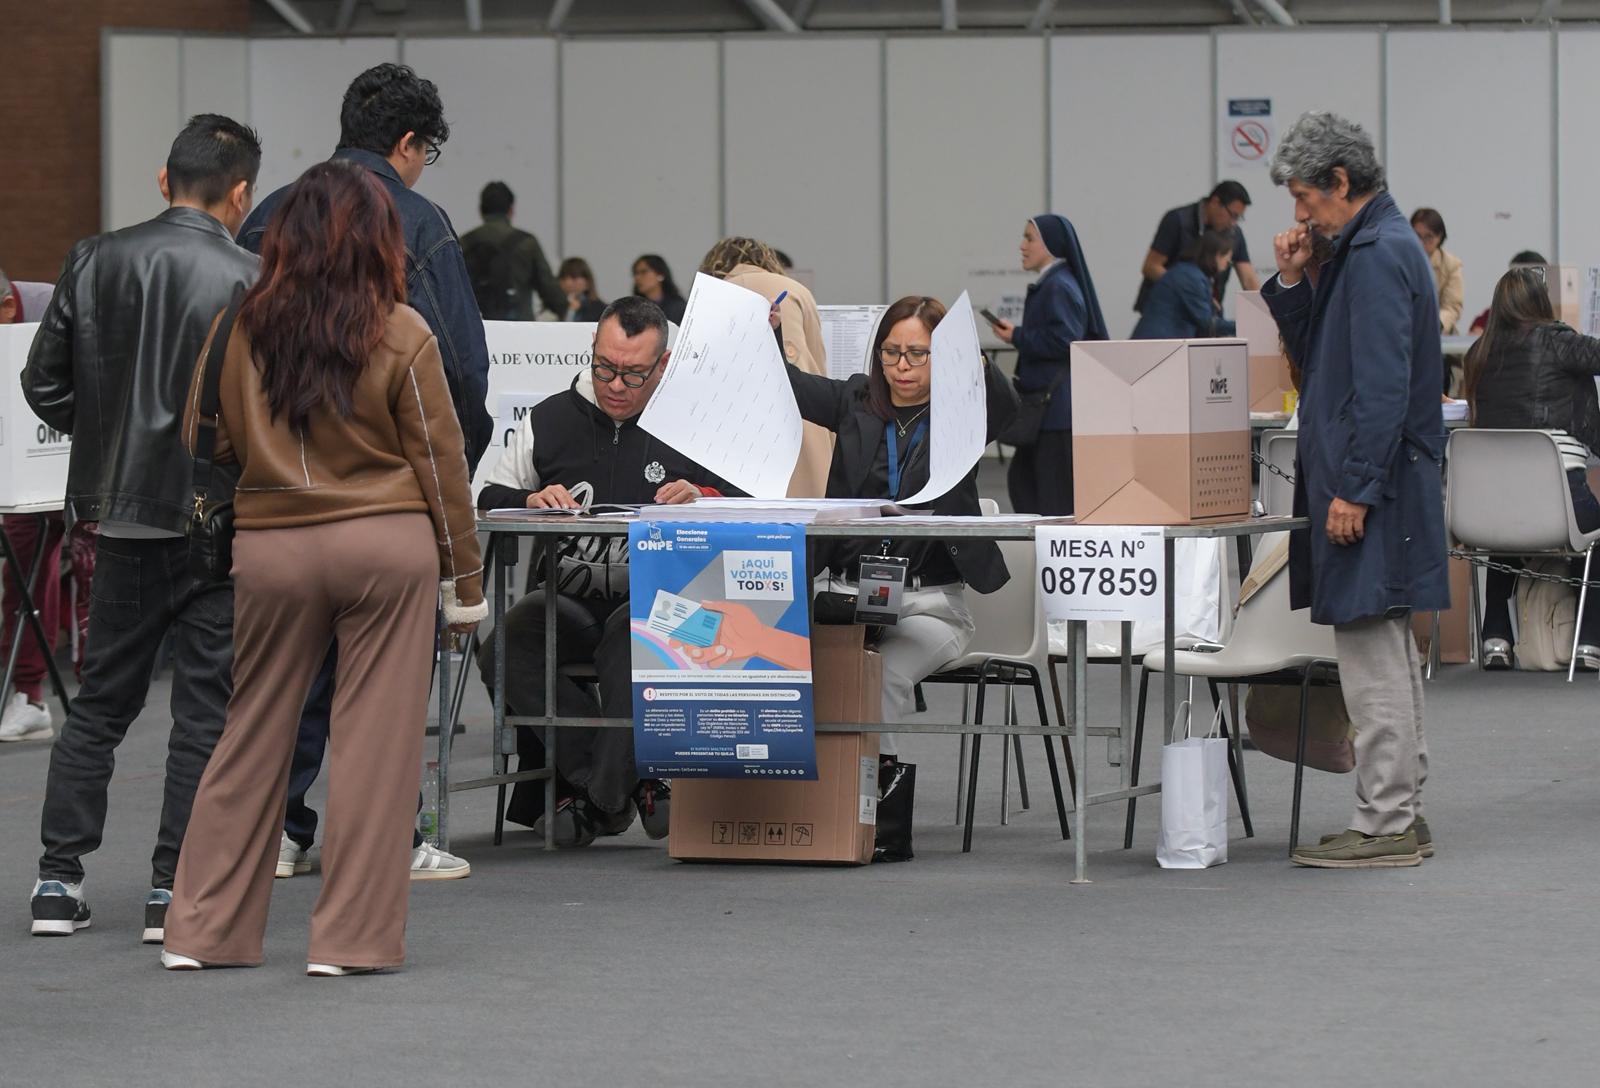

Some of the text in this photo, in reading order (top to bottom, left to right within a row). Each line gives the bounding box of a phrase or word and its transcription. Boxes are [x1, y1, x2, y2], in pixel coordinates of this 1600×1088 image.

[502, 353, 521, 365] DE
[525, 350, 593, 366] VOTACIÓ
[1210, 378, 1227, 394] ONPE
[37, 423, 73, 444] ONP
[637, 540, 673, 551] ONPE
[1050, 540, 1114, 558] MESA
[742, 556, 774, 569] ¡AQUÍ
[730, 570, 788, 580] VOTAMOS
[1041, 567, 1157, 596] 087859
[737, 580, 784, 591] TODXS!
